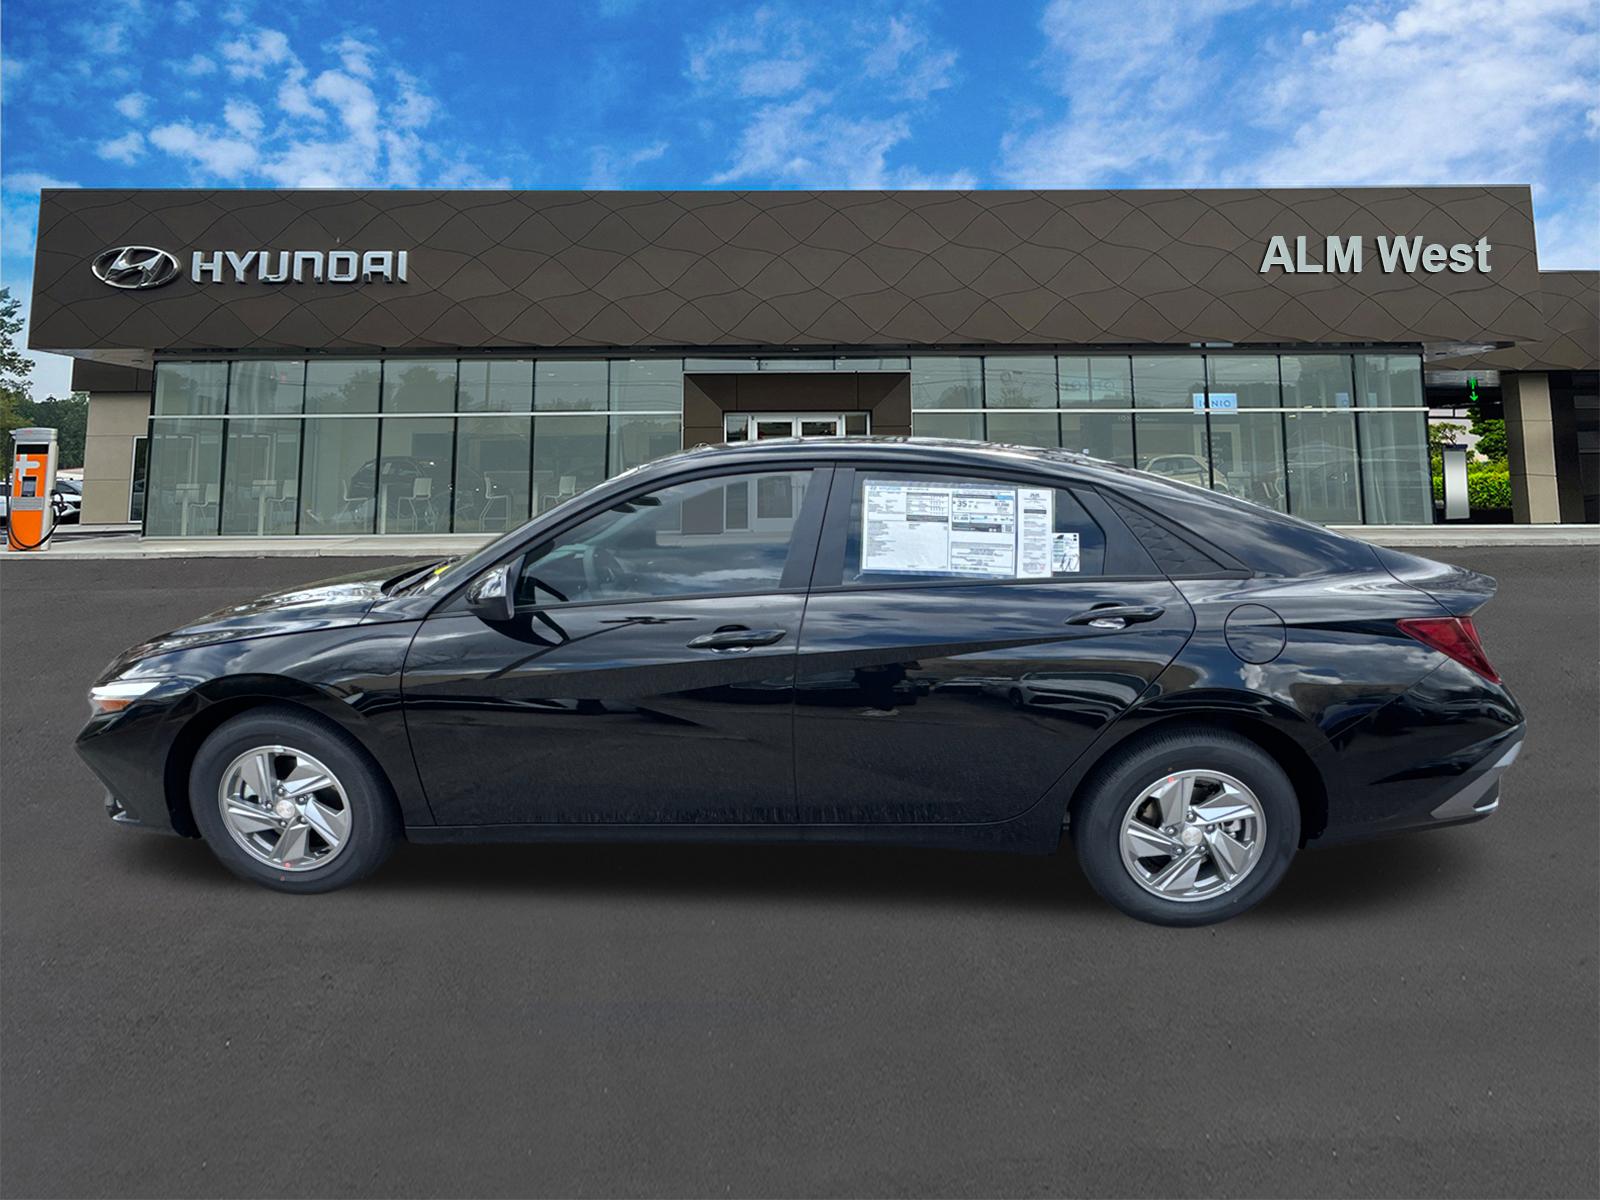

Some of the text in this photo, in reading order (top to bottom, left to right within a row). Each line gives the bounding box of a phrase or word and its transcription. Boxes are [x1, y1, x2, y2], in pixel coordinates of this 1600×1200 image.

[192, 250, 408, 283] HYUNDAI
[1260, 235, 1492, 273] ALM West
